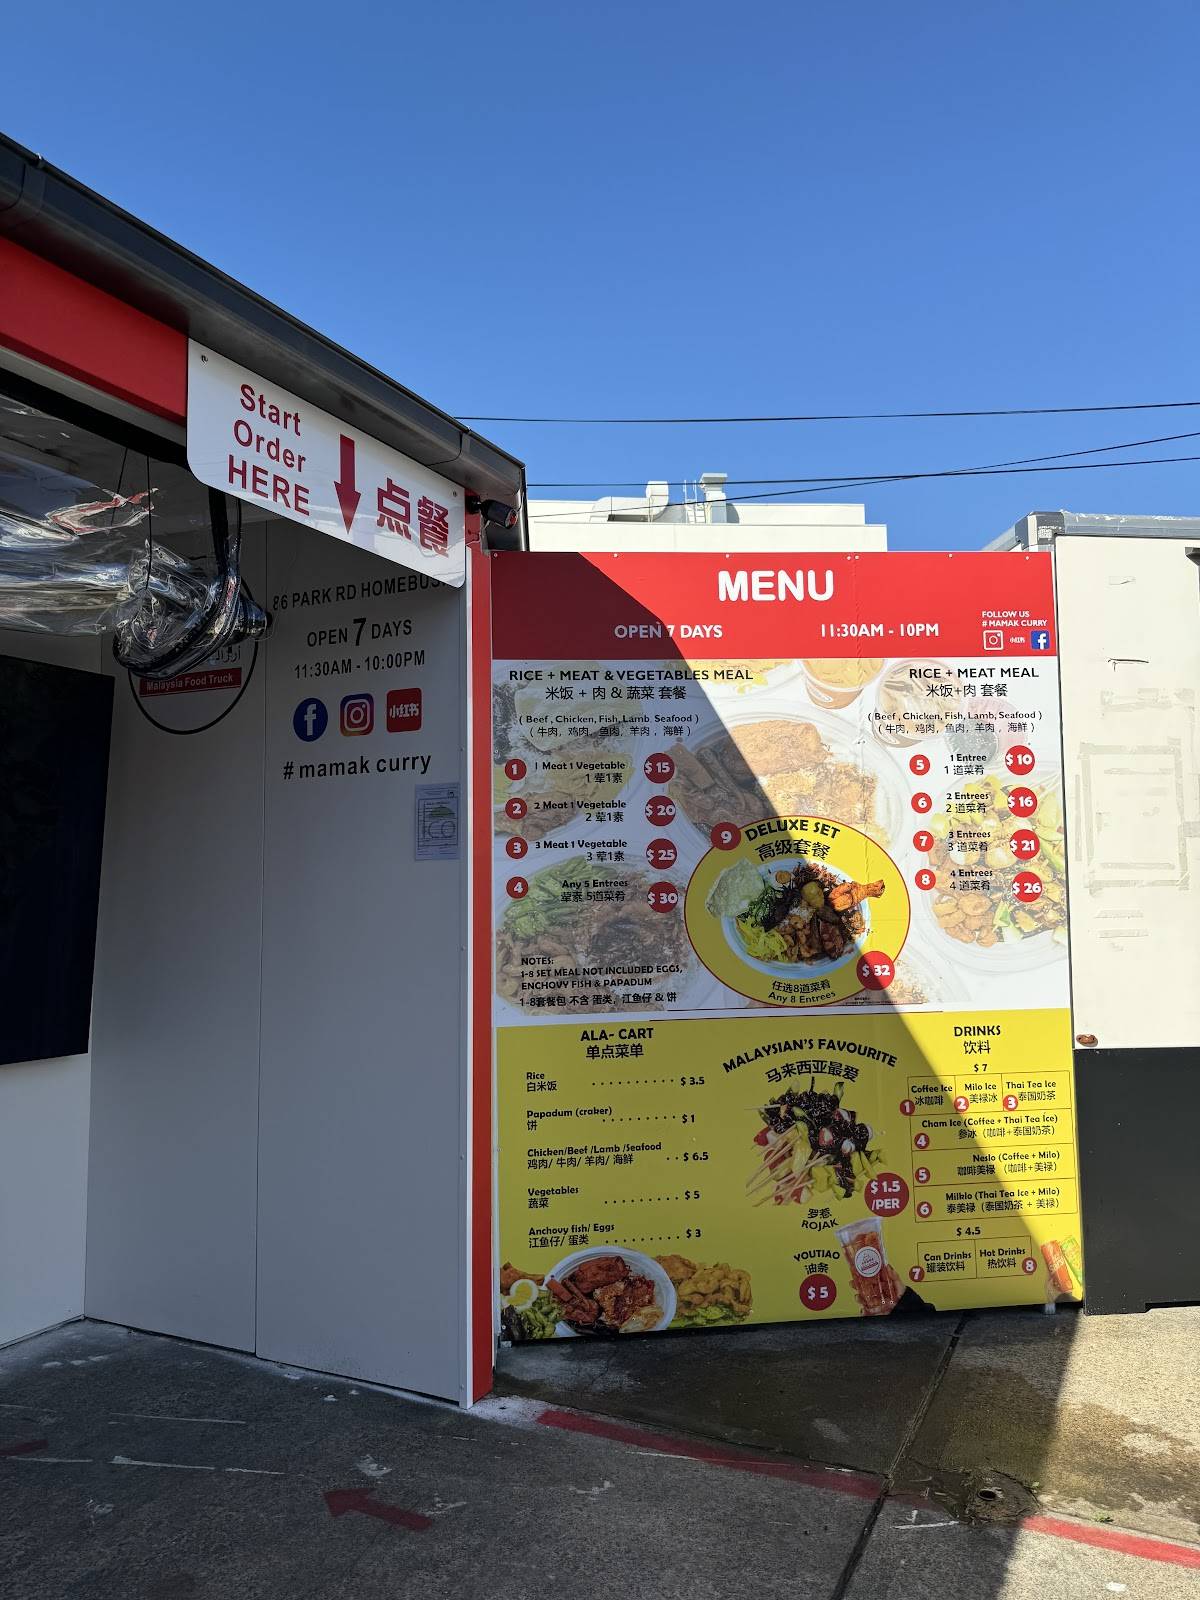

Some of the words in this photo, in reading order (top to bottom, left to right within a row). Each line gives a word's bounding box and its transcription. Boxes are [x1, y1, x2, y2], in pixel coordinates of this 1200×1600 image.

[240, 383, 301, 437] Start
[233, 419, 306, 473] Order
[228, 454, 310, 516] HERE
[376, 477, 449, 558] 点餐
[718, 570, 834, 602] MENU
[272, 595, 288, 611] 86
[293, 588, 332, 608] PARK
[336, 584, 357, 601] RD
[988, 619, 1020, 627] MAMAK
[1021, 619, 1047, 627] CURRY
[307, 627, 348, 647] OPEN
[353, 617, 367, 646] 7
[372, 619, 412, 639] DAYS
[614, 624, 662, 639] OPEN
[667, 624, 674, 638] 7
[680, 624, 723, 639] DAYS
[820, 623, 884, 637] 11:30AM
[900, 623, 940, 637] 10PM
[294, 658, 351, 679] 11:30AM
[365, 650, 425, 671] 10:00PM
[509, 670, 543, 681] RICE
[559, 670, 600, 681] MEAT
[617, 670, 709, 680] VEGETABLES
[714, 670, 754, 680] MEAL
[909, 668, 941, 679] RICE
[957, 668, 996, 679] MEAT
[1000, 668, 1039, 679] MEAL
[146, 679, 183, 691] Malaysia
[184, 675, 207, 687] Food
[208, 673, 233, 685] Truck
[390, 702, 419, 718] 小红书
[956, 754, 987, 762] Entree
[283, 761, 294, 780] #
[299, 756, 370, 779] mamak
[376, 755, 431, 775] curry
[542, 762, 568, 770] Meat
[576, 761, 626, 771] Vegetable
[955, 792, 989, 800] Entrees
[543, 801, 569, 809] Meat
[577, 800, 627, 810] Vegetable
[744, 819, 809, 842] DELUXE
[813, 822, 841, 839] SET
[949, 831, 954, 839] 3
[721, 831, 732, 843] 9
[535, 841, 541, 849] 3
[578, 840, 627, 850] Vegetable
[755, 839, 831, 862] 高级套餐
[958, 869, 993, 877] Entrees
[562, 880, 582, 890] Any
[584, 880, 590, 888] 5
[521, 957, 554, 965] NOTES:
[521, 970, 534, 978] 1-8
[536, 969, 551, 978] SET
[554, 968, 580, 976] MEAL
[582, 968, 603, 976] NOT
[605, 966, 654, 975] INCLUDED
[656, 965, 683, 974] EGGS,
[521, 981, 569, 990] ENCHOVY
[571, 980, 592, 989] FISH
[604, 978, 652, 987] PAPADUM
[768, 992, 789, 1004] Any
[790, 995, 796, 1003] 8
[799, 991, 836, 1003] Entrees
[618, 1027, 654, 1040] CART
[954, 1025, 1001, 1037] DRINKS
[585, 1044, 644, 1060] 单点菜单
[963, 1040, 991, 1055] 饮料
[722, 1039, 814, 1073] MALAYSIAN'S
[818, 1039, 898, 1068] FAVOURITE
[526, 1072, 545, 1080] Rice
[765, 1060, 859, 1083] 马来西亚最爱
[526, 1081, 558, 1093] 白米饭
[911, 1085, 939, 1094] Coffee
[943, 1084, 953, 1092] Ice
[964, 1083, 983, 1091] Milo
[1006, 1081, 1025, 1089] Thai
[1027, 1081, 1042, 1089] Tea
[1044, 1080, 1056, 1088] Ice
[914, 1096, 944, 1106] 冰咖啡
[1018, 1091, 1056, 1101] 泰国奶茶
[527, 1109, 573, 1120] Papadum
[922, 1119, 948, 1128] Cham
[950, 1119, 962, 1127] Ice
[1004, 1116, 1023, 1124] Thai
[1024, 1115, 1040, 1123] Tea
[973, 1154, 996, 1163] Neslo
[527, 1186, 579, 1197] Vegetables
[999, 1190, 1015, 1198] Tea
[528, 1198, 549, 1209] 蔬菜
[871, 1199, 900, 1210] /PER
[529, 1226, 569, 1236] Anchovy
[593, 1223, 615, 1232] Eggs
[801, 1219, 839, 1232] ROJAK
[793, 1249, 840, 1262] YOUTIAO
[943, 1251, 972, 1260] Drinks
[979, 1249, 996, 1257] Hot
[998, 1247, 1026, 1256] Drinks
[926, 1262, 966, 1273] 罐装饮料
[987, 1258, 1016, 1269] 热饮料
